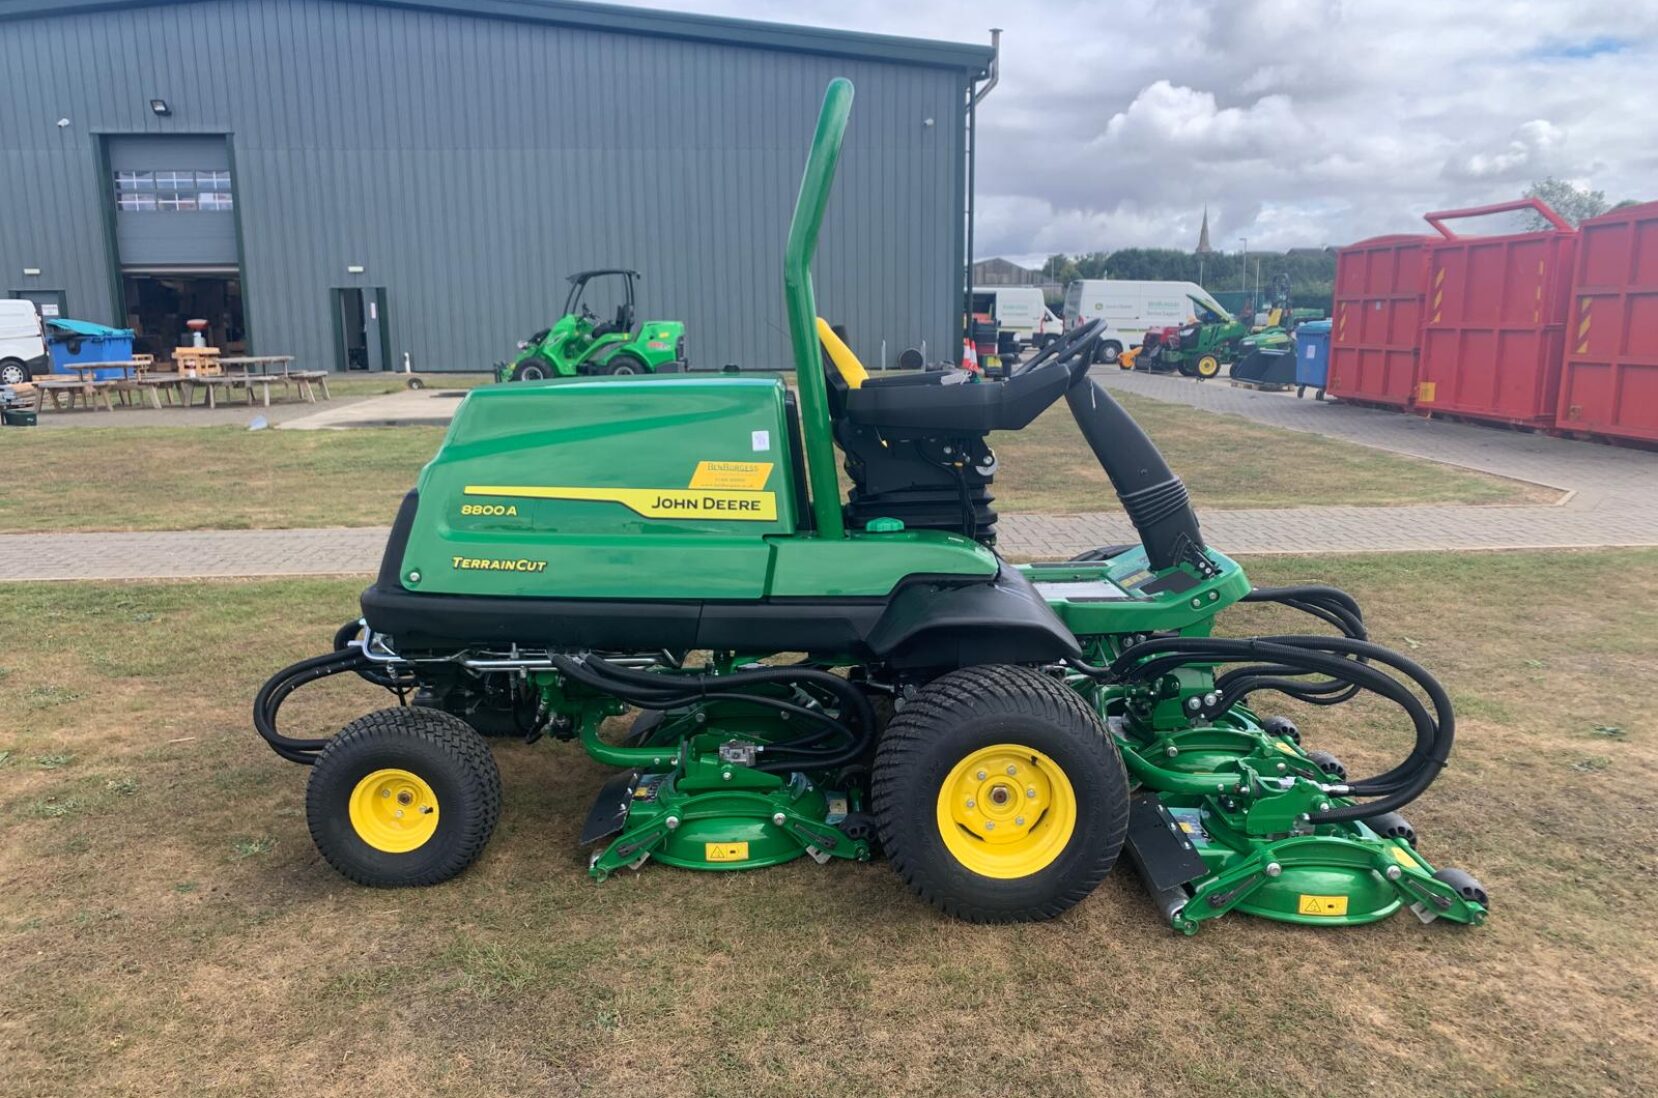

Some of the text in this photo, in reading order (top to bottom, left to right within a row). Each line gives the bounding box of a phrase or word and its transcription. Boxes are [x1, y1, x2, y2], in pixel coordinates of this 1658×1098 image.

[651, 496, 761, 511] JOHN DEERE
[452, 556, 547, 571] TERRAINCUT
